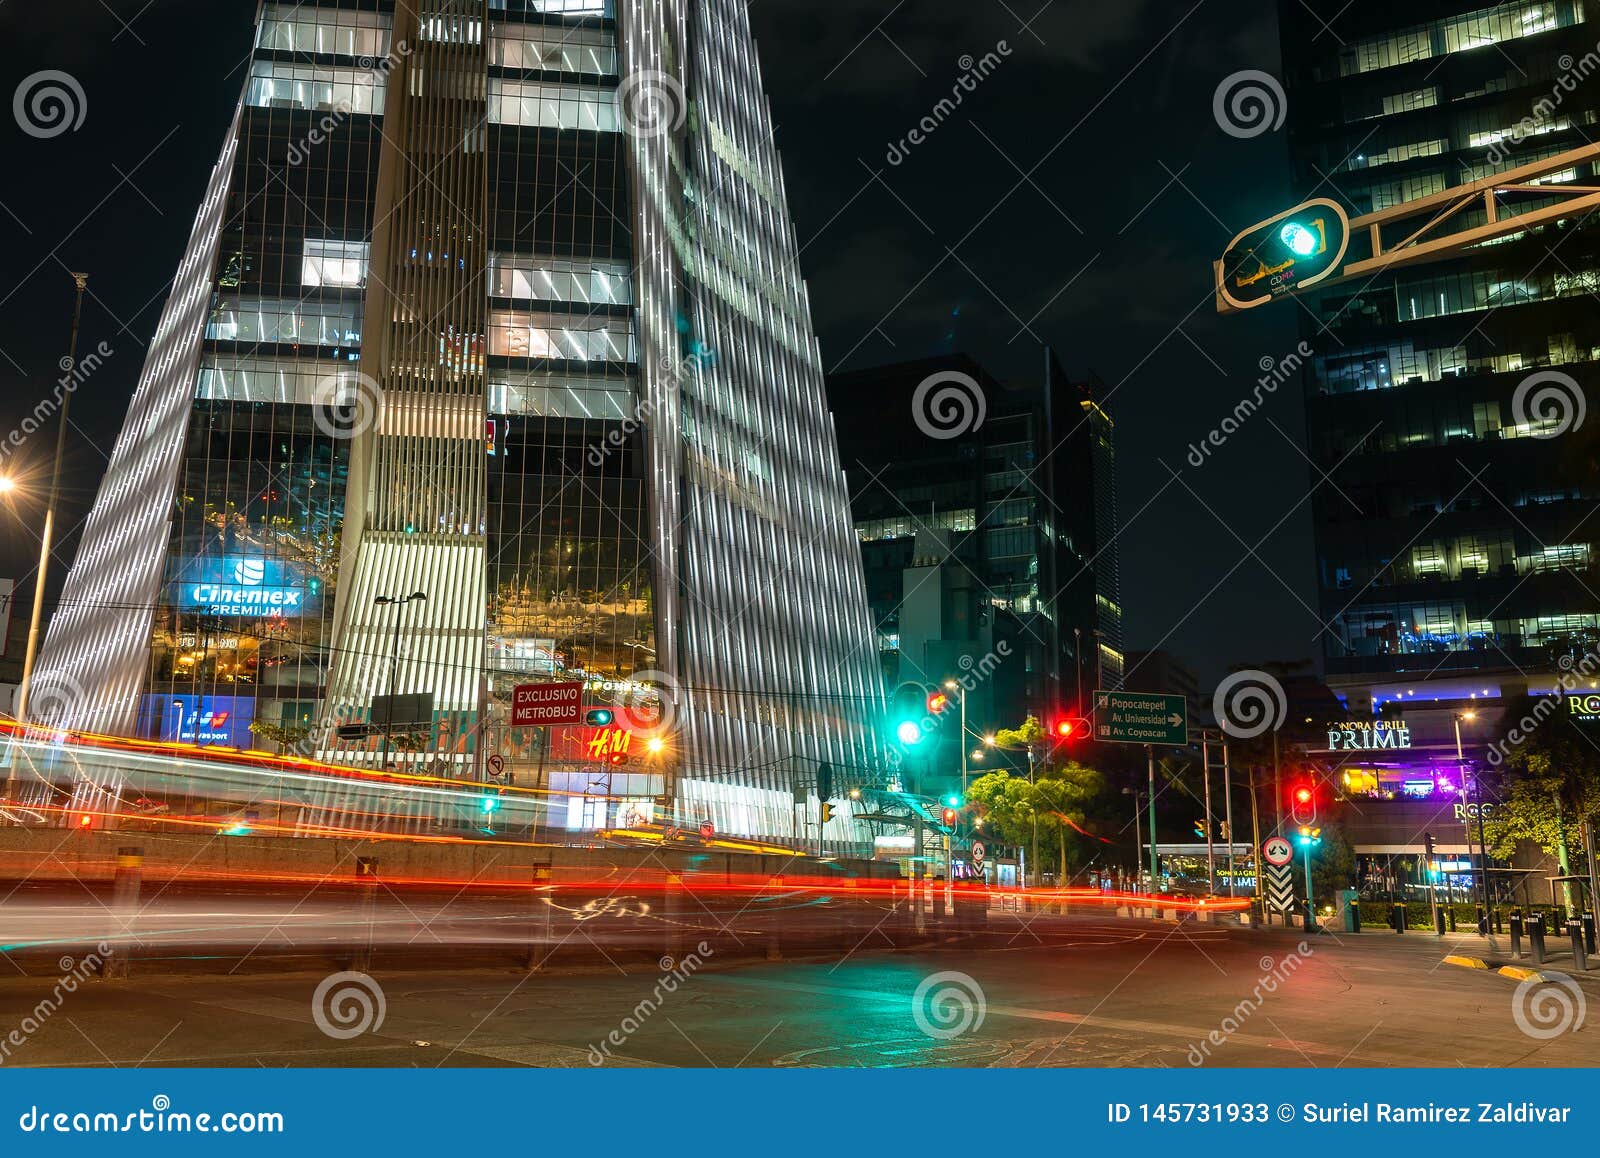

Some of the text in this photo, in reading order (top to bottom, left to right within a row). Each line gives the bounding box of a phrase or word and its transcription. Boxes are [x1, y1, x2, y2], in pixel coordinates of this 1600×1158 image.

[1270, 270, 1295, 286] CDMX
[193, 585, 300, 605] Cinemex
[209, 604, 283, 616] PREMIUM
[518, 688, 578, 703] EXCLUSIVO
[1111, 698, 1166, 711] Popocatepetl
[516, 705, 577, 719] METROBUS
[1112, 713, 1166, 725] Av. Universidad
[1374, 720, 1406, 730] GRILL
[1113, 727, 1167, 738] Av. Coyoacan
[1327, 728, 1411, 750] PRIME
[587, 728, 633, 758] H&M
